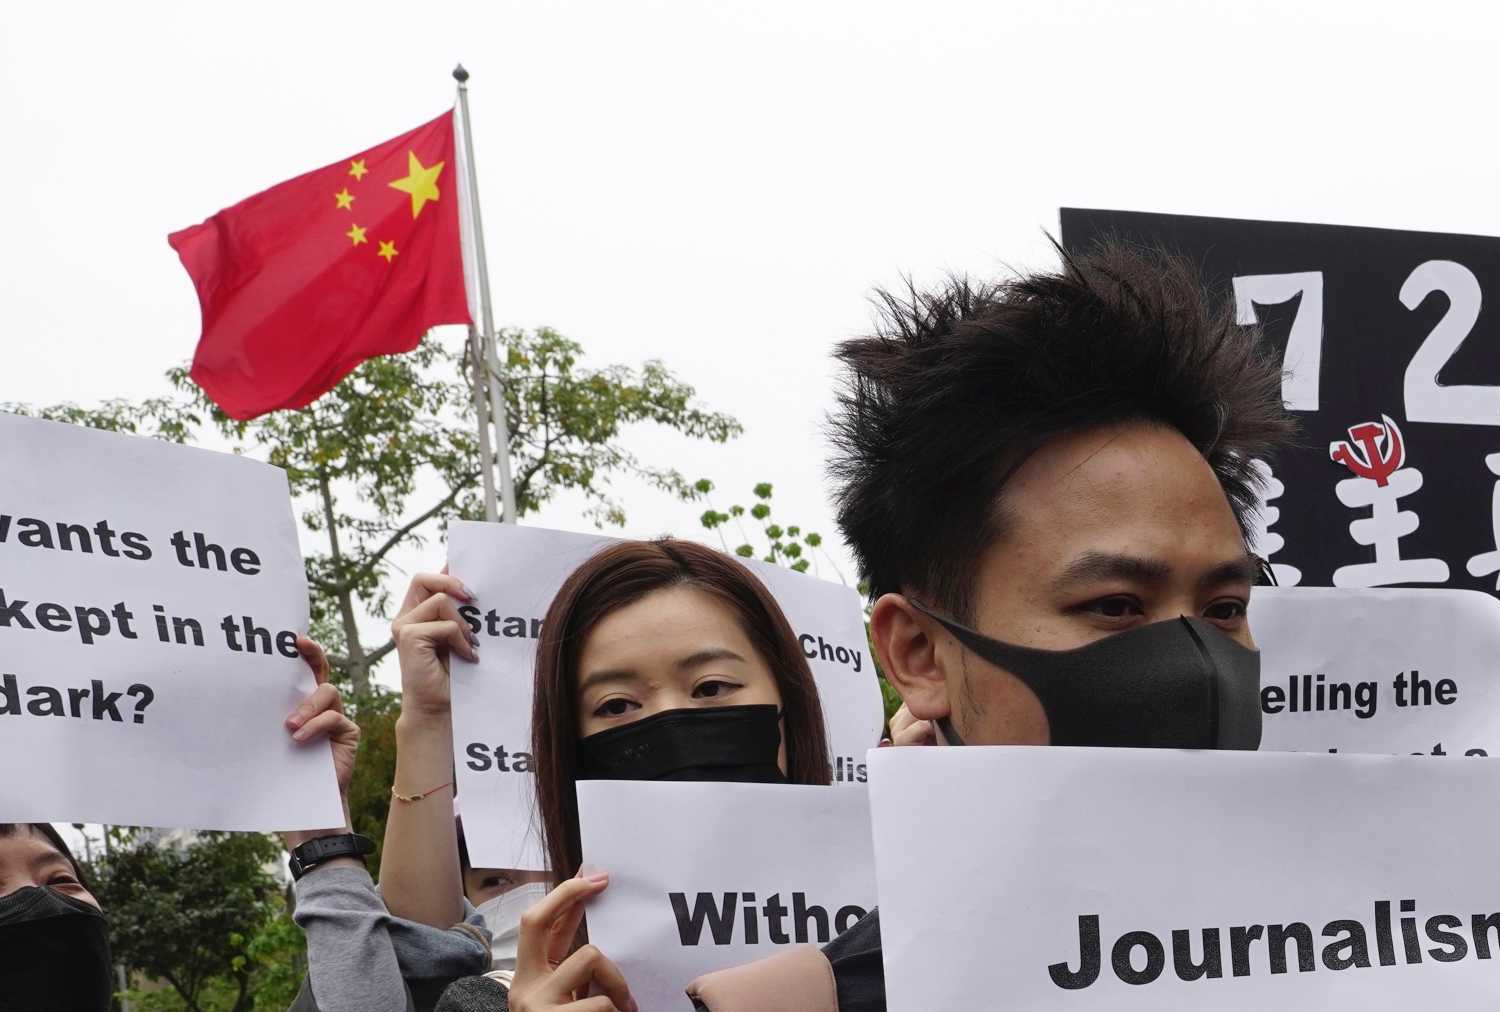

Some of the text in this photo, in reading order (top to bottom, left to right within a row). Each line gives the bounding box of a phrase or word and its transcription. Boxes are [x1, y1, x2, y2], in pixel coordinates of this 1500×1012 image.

[0, 515, 261, 576] ants the
[0, 588, 299, 659] kept in the
[798, 633, 862, 673] Choy
[0, 673, 154, 724] dark?
[1260, 670, 1458, 719] elling the
